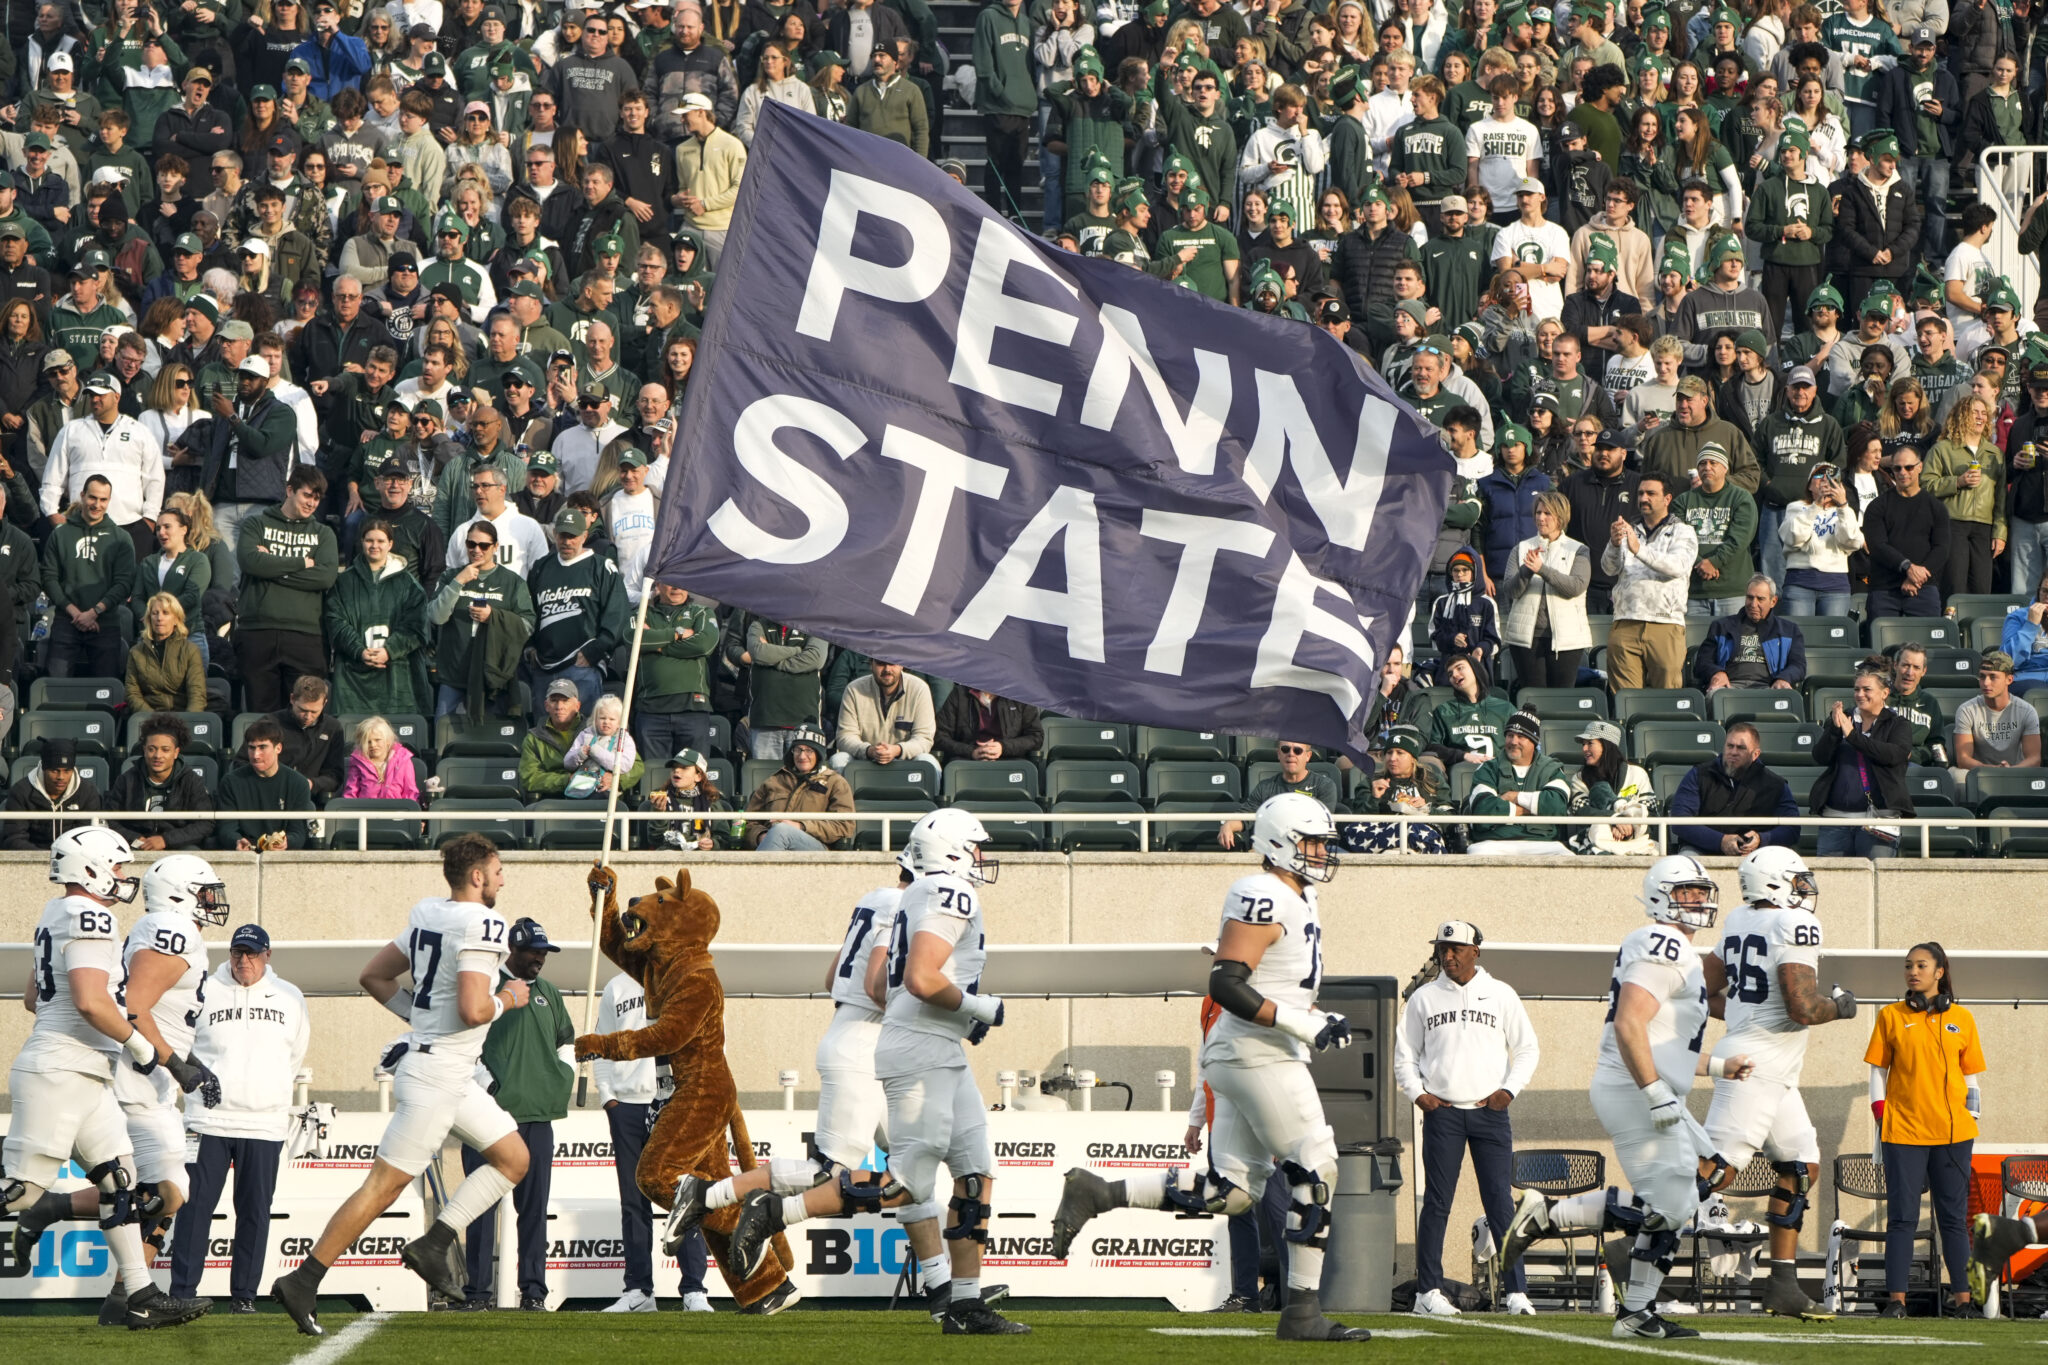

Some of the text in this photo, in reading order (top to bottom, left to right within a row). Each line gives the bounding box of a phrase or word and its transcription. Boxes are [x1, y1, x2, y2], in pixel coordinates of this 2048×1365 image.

[1833, 28, 1881, 41] HOMECOMING
[1404, 133, 1444, 155] STATE
[1484, 132, 1527, 143] RAISE YOUR
[1485, 142, 1526, 157] SHIELD
[1738, 311, 1758, 327] STATE
[69, 335, 99, 345] STATE
[796, 168, 1398, 552] PENN
[120, 432, 130, 442] S
[264, 527, 319, 547] MICHIGAN
[614, 515, 655, 537] PILOTS
[269, 543, 312, 559] STATE
[707, 393, 1374, 721] STATE
[537, 586, 592, 605] Michigan
[541, 602, 585, 616] State
[1452, 724, 1499, 736] MICHIGAN STATE
[1910, 708, 1932, 730] STATE
[1978, 721, 2018, 734] MICHIGAN
[1464, 734, 1494, 760] 9
[1985, 731, 2011, 741] STATE
[938, 888, 973, 916] 70
[1241, 896, 1274, 922] 72
[80, 911, 113, 935] 63
[482, 919, 506, 943] 17
[154, 929, 187, 955] 50
[1795, 925, 1820, 947] 66
[1649, 933, 1681, 963] 76
[409, 928, 443, 1011] 17
[1723, 934, 1769, 1005] 66
[209, 1008, 285, 1026] PENN STATE
[616, 996, 645, 1018] PENN
[1427, 1009, 1497, 1031] PENN STATE
[1086, 1143, 1191, 1159] GRAINGER
[1091, 1237, 1214, 1258] GRAINGER
